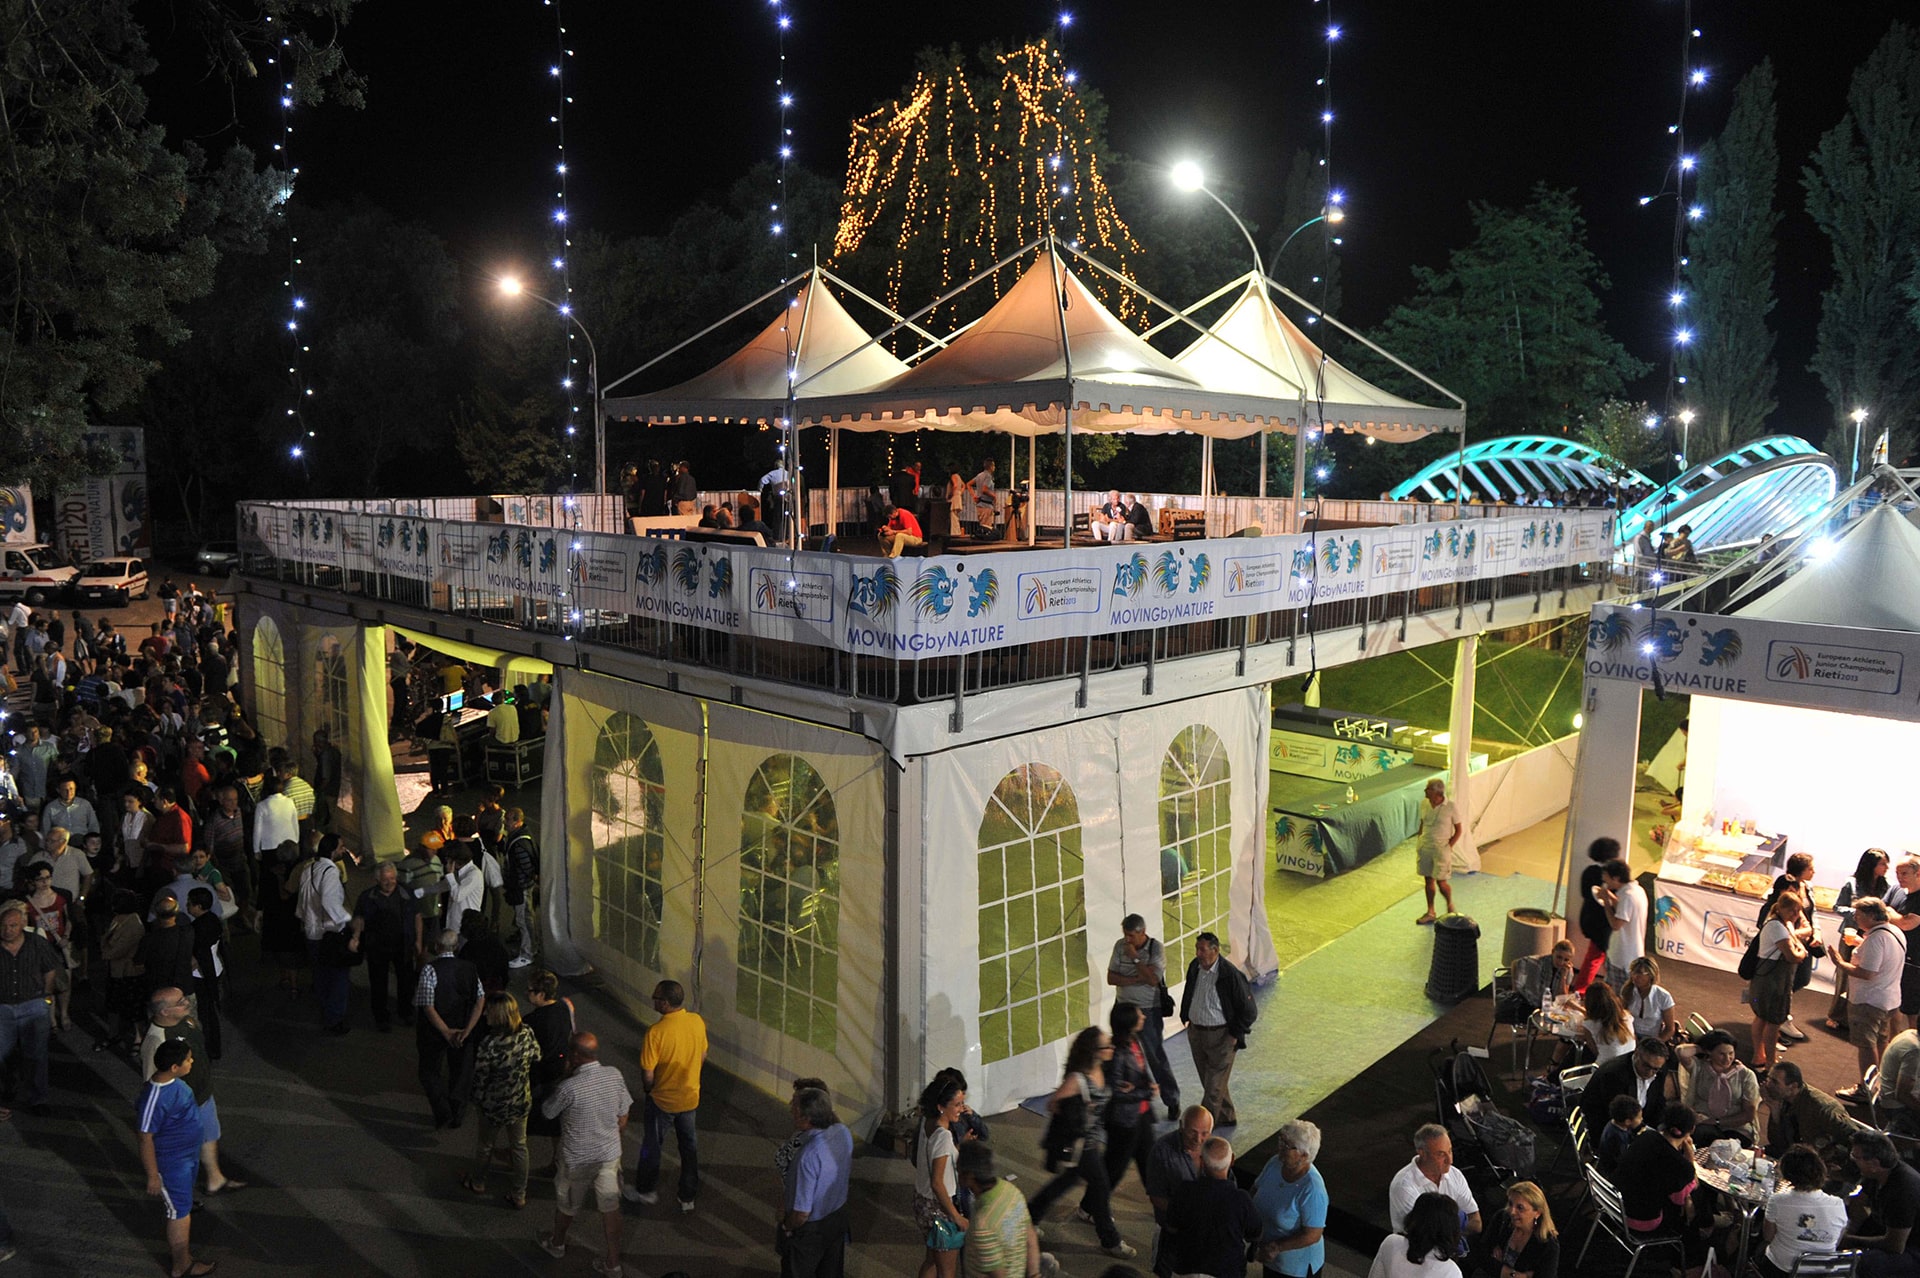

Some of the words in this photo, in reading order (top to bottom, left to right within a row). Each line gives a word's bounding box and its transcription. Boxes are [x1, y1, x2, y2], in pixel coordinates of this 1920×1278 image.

[87, 478, 105, 561] OVINGbyNATURE
[487, 573, 562, 598] MOVINGbyNATURE
[1288, 580, 1365, 602] MOVNGbyNATURE
[636, 594, 739, 628] MOVINGbyNATURE
[1110, 600, 1214, 626] MOVINGbyNATURE
[847, 624, 1004, 653] MOVINGbyNATURE
[1815, 660, 1838, 669] Junior
[1839, 662, 1896, 676] Championships
[1817, 652, 1852, 662] European
[1852, 656, 1886, 666] Athletics
[1584, 660, 1748, 694] OVINGyNATURE
[1276, 853, 1323, 874] VINGby
[1657, 936, 1685, 955] URE
